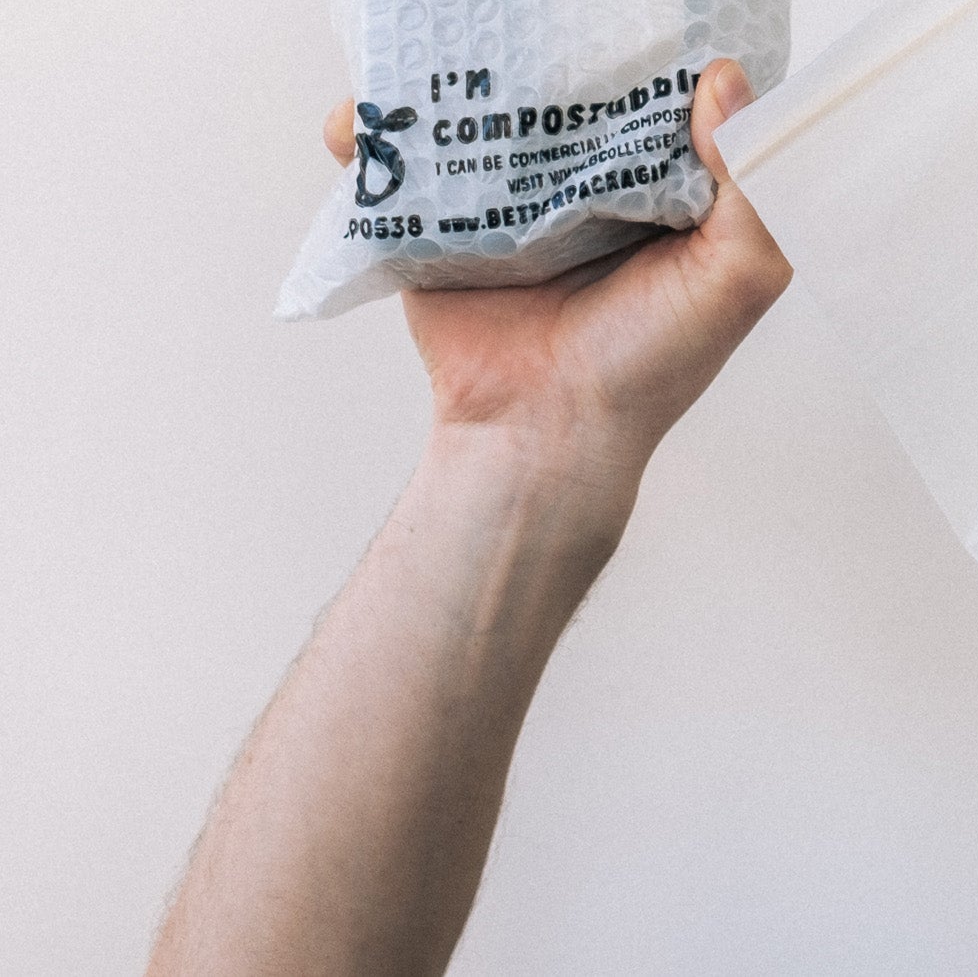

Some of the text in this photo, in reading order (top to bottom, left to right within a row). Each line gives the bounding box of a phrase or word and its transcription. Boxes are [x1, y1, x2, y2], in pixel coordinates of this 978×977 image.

[435, 162, 441, 176] I
[447, 157, 478, 176] CAN
[482, 154, 504, 172] BE
[506, 172, 544, 195] VISIT
